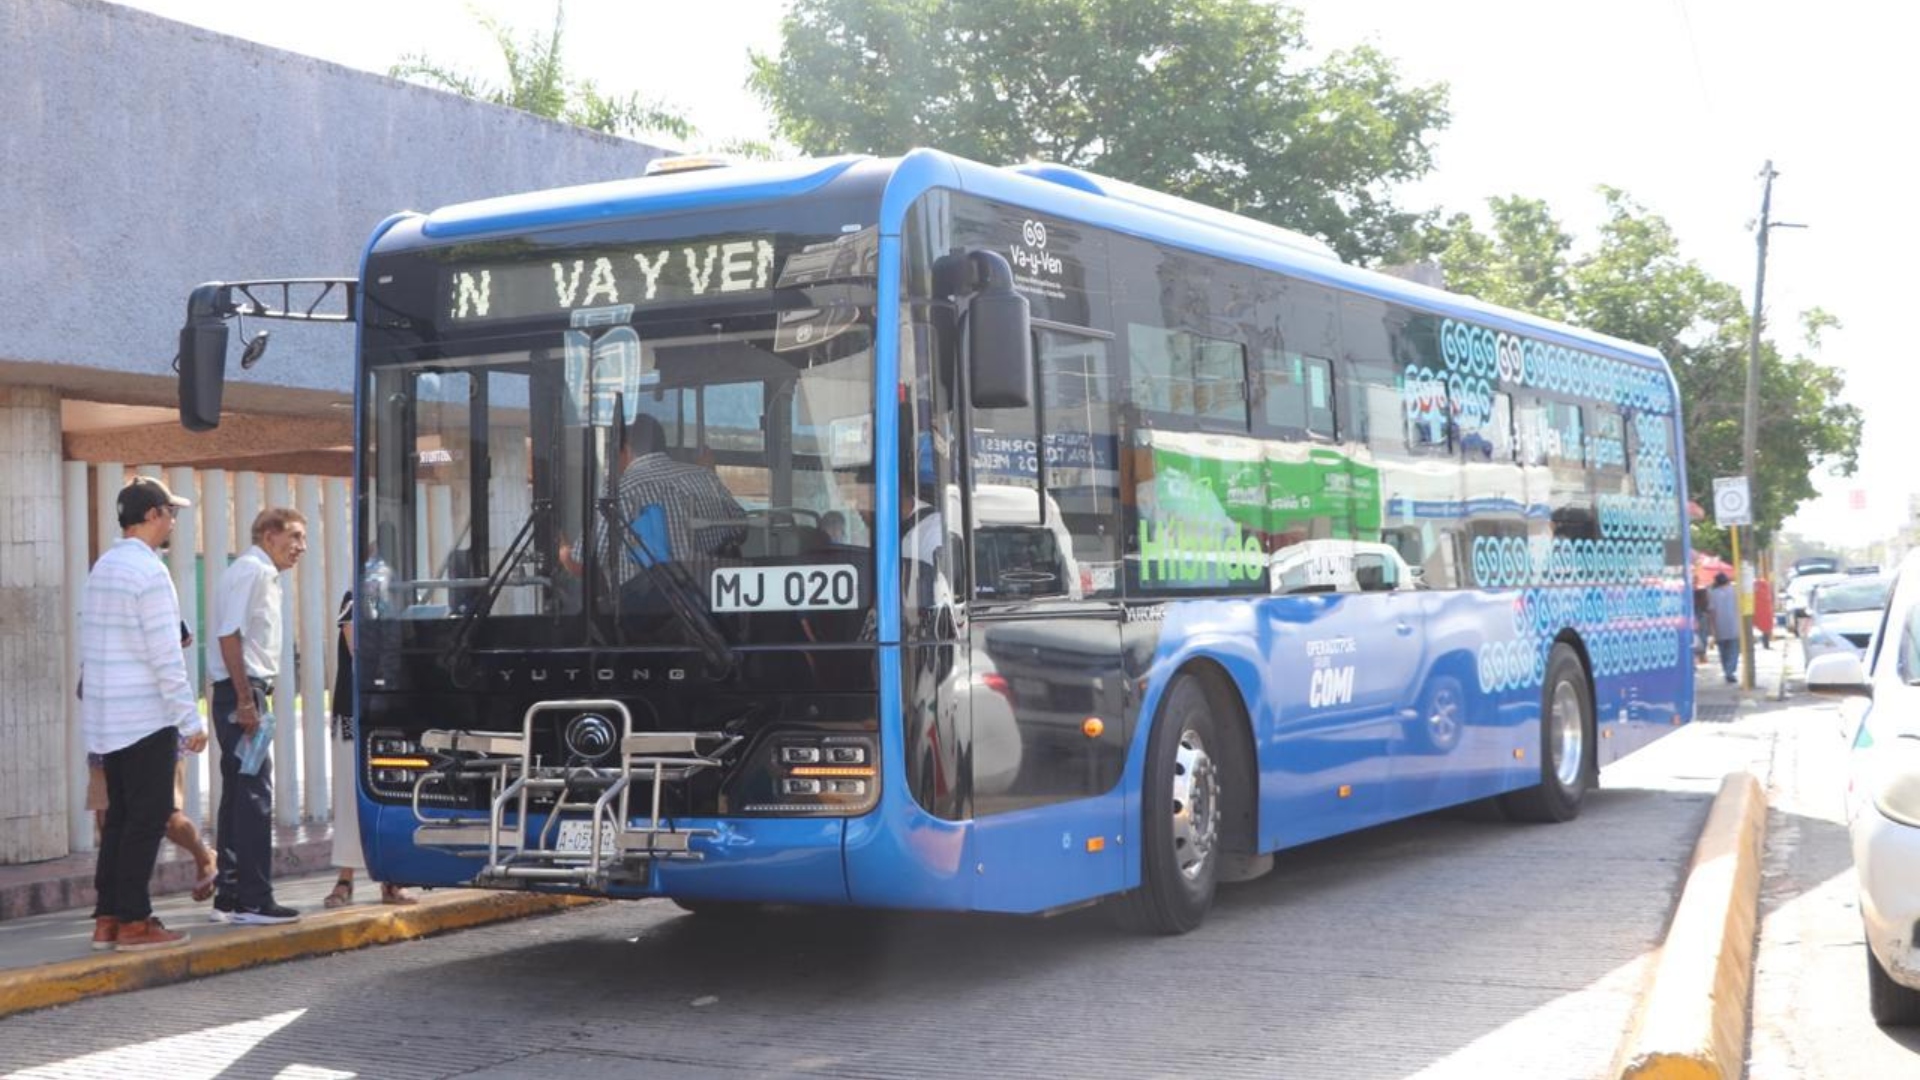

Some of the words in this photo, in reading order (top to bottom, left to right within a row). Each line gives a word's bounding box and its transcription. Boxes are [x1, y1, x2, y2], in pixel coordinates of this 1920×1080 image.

[552, 257, 618, 308] VA
[634, 250, 670, 300] Y
[1010, 244, 1063, 276] Va-y-Ven
[1139, 514, 1263, 581] Híbrido
[716, 572, 765, 608] MJ
[784, 570, 855, 607] 020
[499, 668, 686, 682] YUTONG
[1309, 665, 1356, 709] COMI
